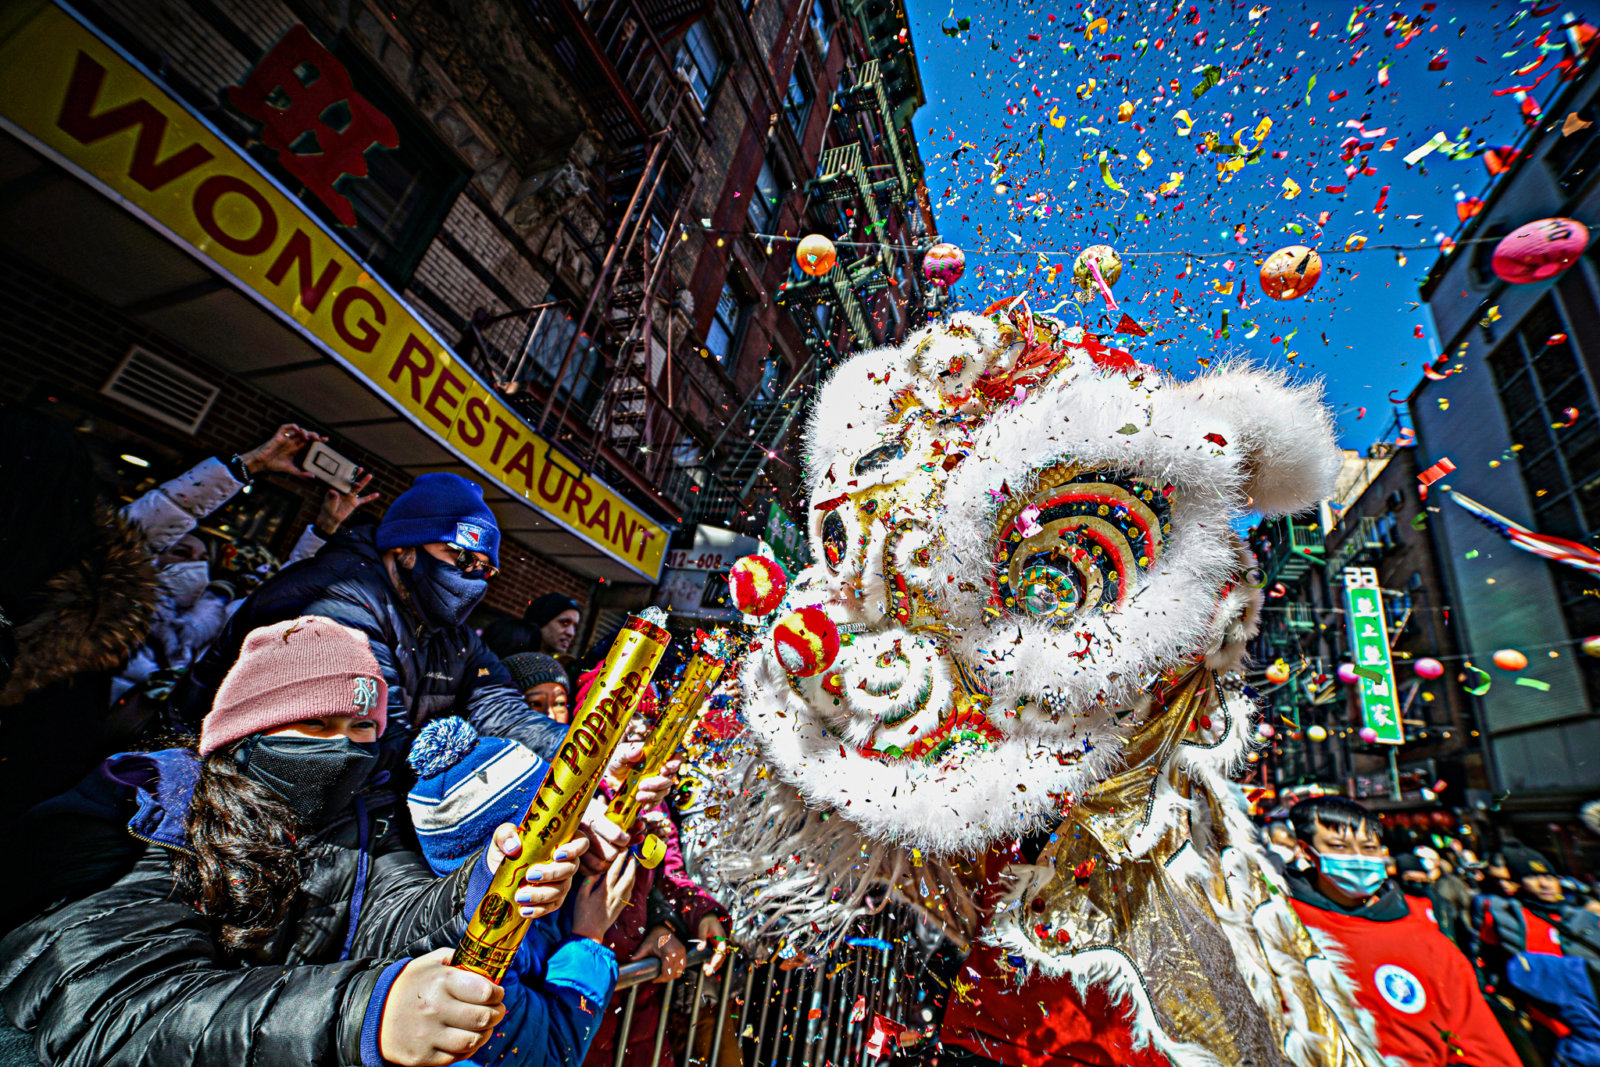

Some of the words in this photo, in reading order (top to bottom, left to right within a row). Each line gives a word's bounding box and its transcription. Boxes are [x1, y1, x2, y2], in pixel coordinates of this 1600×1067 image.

[57, 50, 387, 354] WONG
[388, 333, 655, 562] RESTAURANT
[668, 551, 741, 570] 212-608-
[559, 671, 646, 776] POPPER
